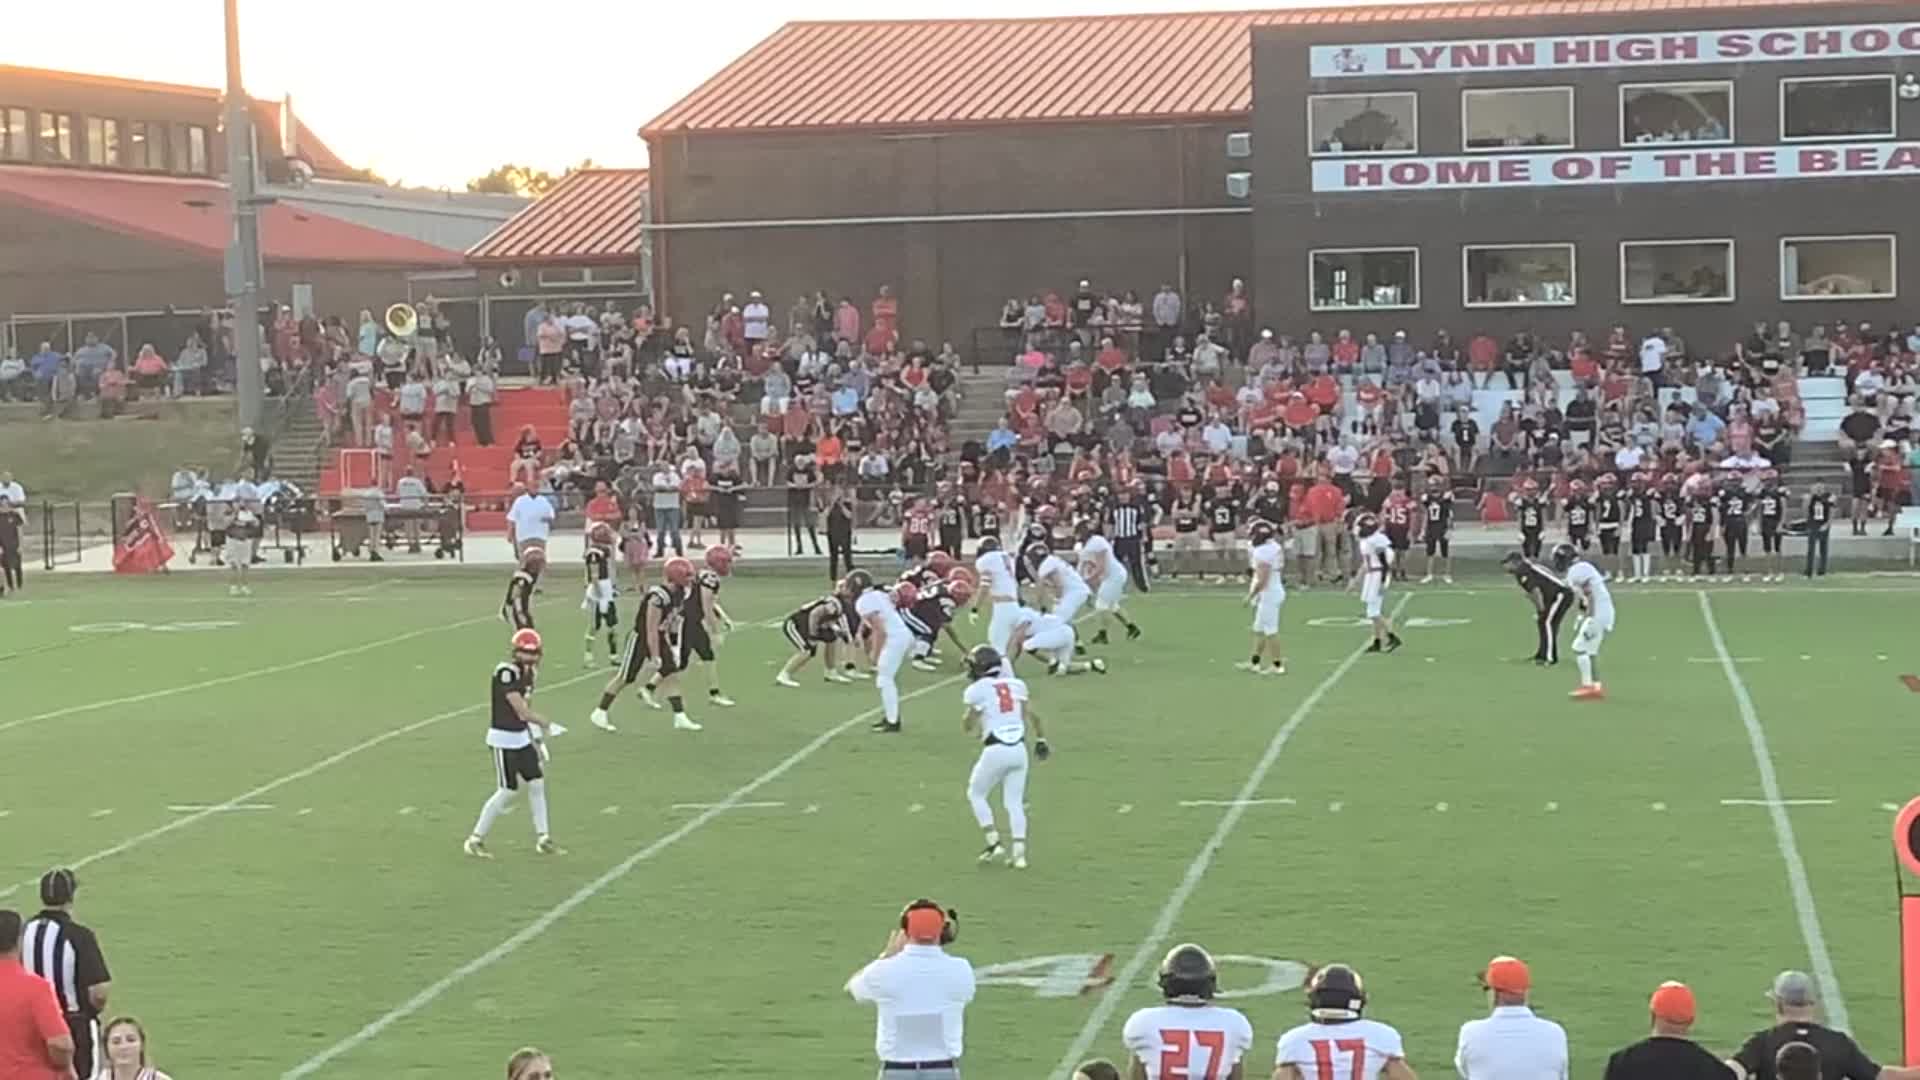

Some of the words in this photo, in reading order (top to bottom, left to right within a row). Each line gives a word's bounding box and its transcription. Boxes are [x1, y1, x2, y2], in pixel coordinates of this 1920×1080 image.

[1386, 42, 1536, 70] LYNN
[1552, 36, 1698, 65] HIGH
[1344, 159, 1532, 187] HOME
[1551, 154, 1633, 180] OF
[1653, 151, 1777, 177] THE
[1797, 146, 1920, 173] BEA
[1159, 1029, 1225, 1080] 27
[1308, 1039, 1366, 1080] 17
